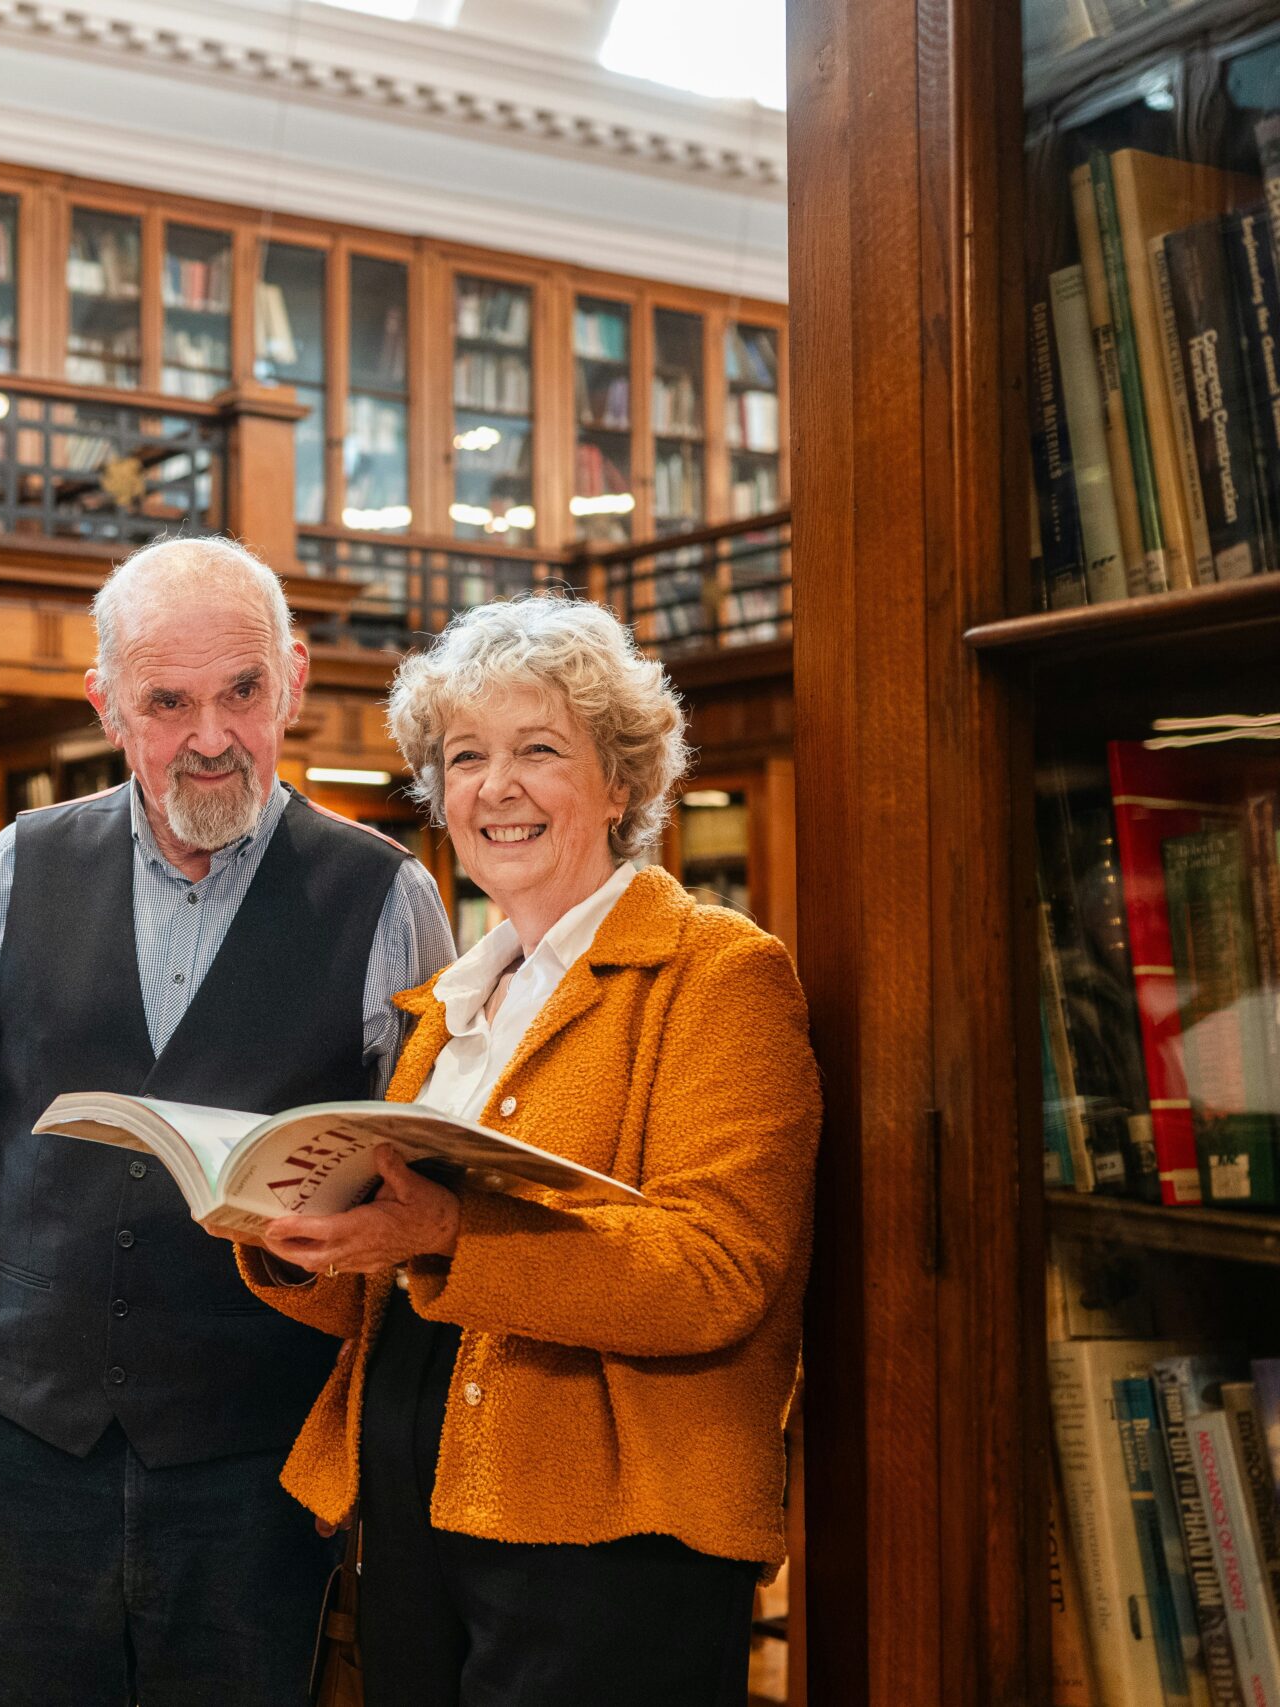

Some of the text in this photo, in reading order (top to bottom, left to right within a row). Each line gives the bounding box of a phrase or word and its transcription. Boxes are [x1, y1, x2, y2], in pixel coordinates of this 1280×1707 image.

[1241, 216, 1264, 304] Engineering
[1257, 306, 1270, 332] the
[1033, 302, 1062, 479] CONSTRUCTION MATERIALS
[1188, 335, 1212, 422] Handbook
[1203, 329, 1239, 524] Concrete Construction
[266, 1126, 358, 1209] ART
[290, 1142, 374, 1214] SCHOOL
[1165, 1387, 1184, 1421] FROM
[1168, 1426, 1195, 1474] FURY
[1181, 1498, 1223, 1606] PHANTOM
[1199, 1431, 1247, 1612] MECHANICS OF FLIGHT
